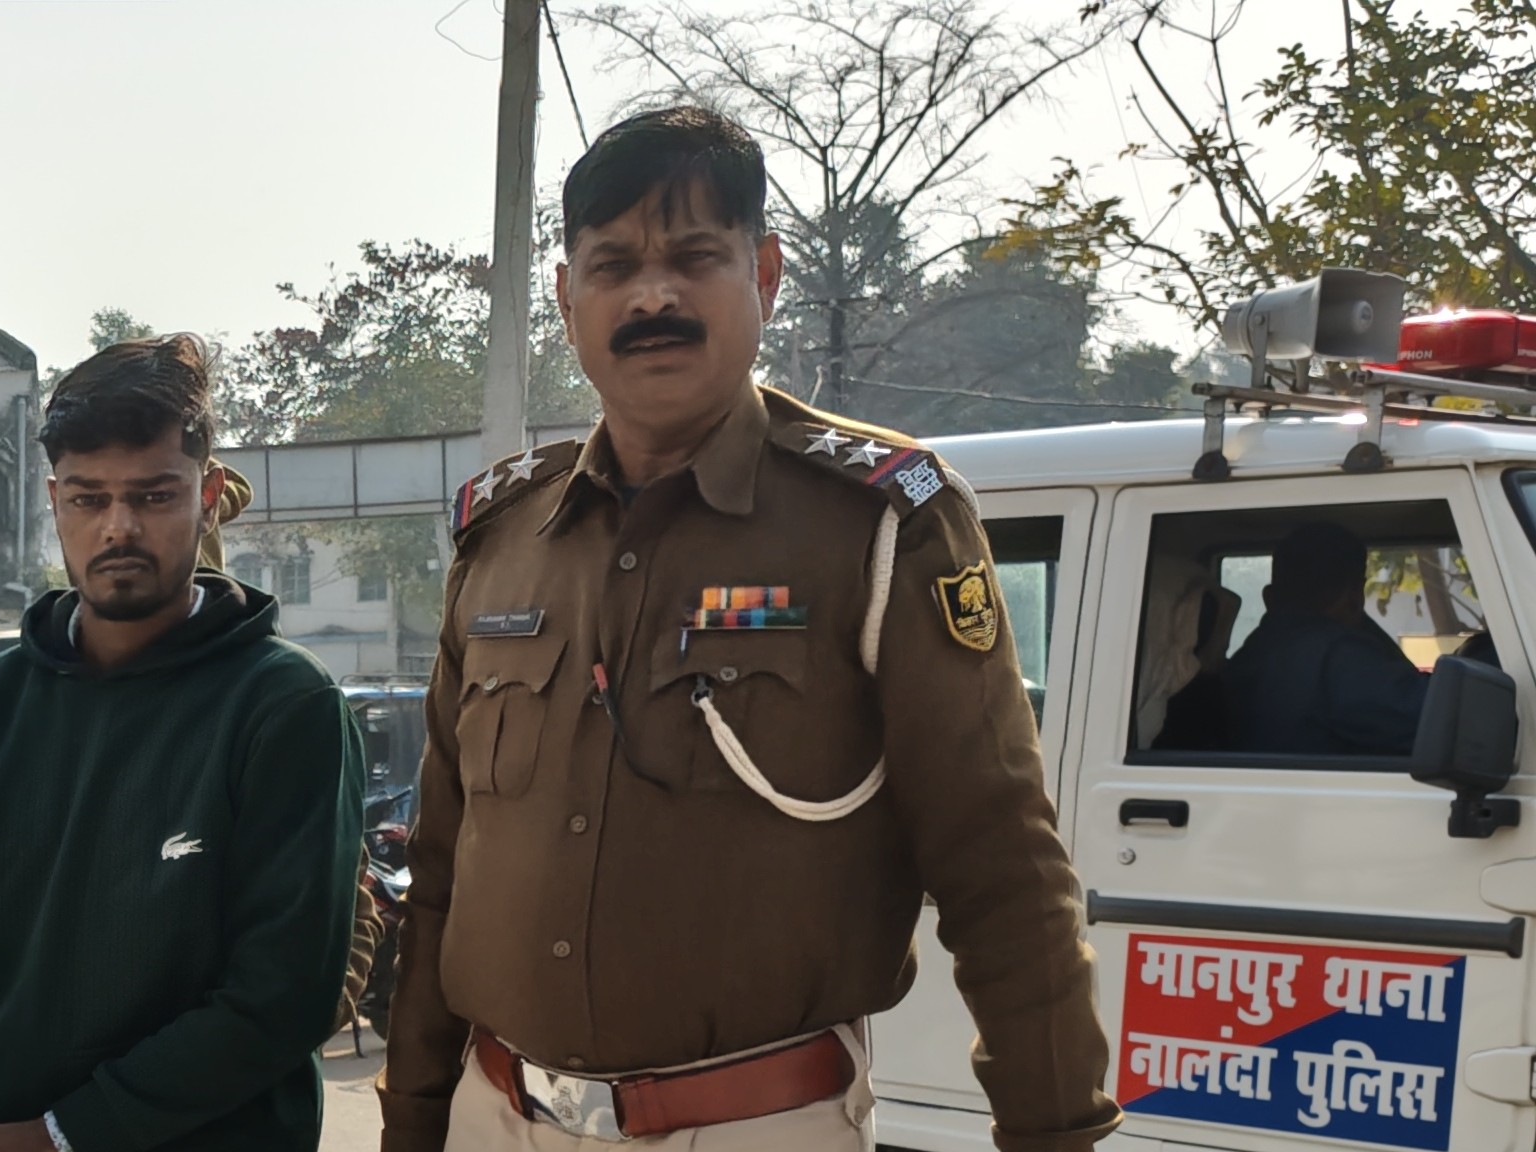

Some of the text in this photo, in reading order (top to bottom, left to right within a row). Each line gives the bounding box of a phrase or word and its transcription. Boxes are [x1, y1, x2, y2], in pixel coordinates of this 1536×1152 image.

[1397, 349, 1433, 361] PHON
[1137, 941, 1454, 1026] मानपुर थाना
[1127, 1025, 1445, 1128] नालंदा पुलिस
